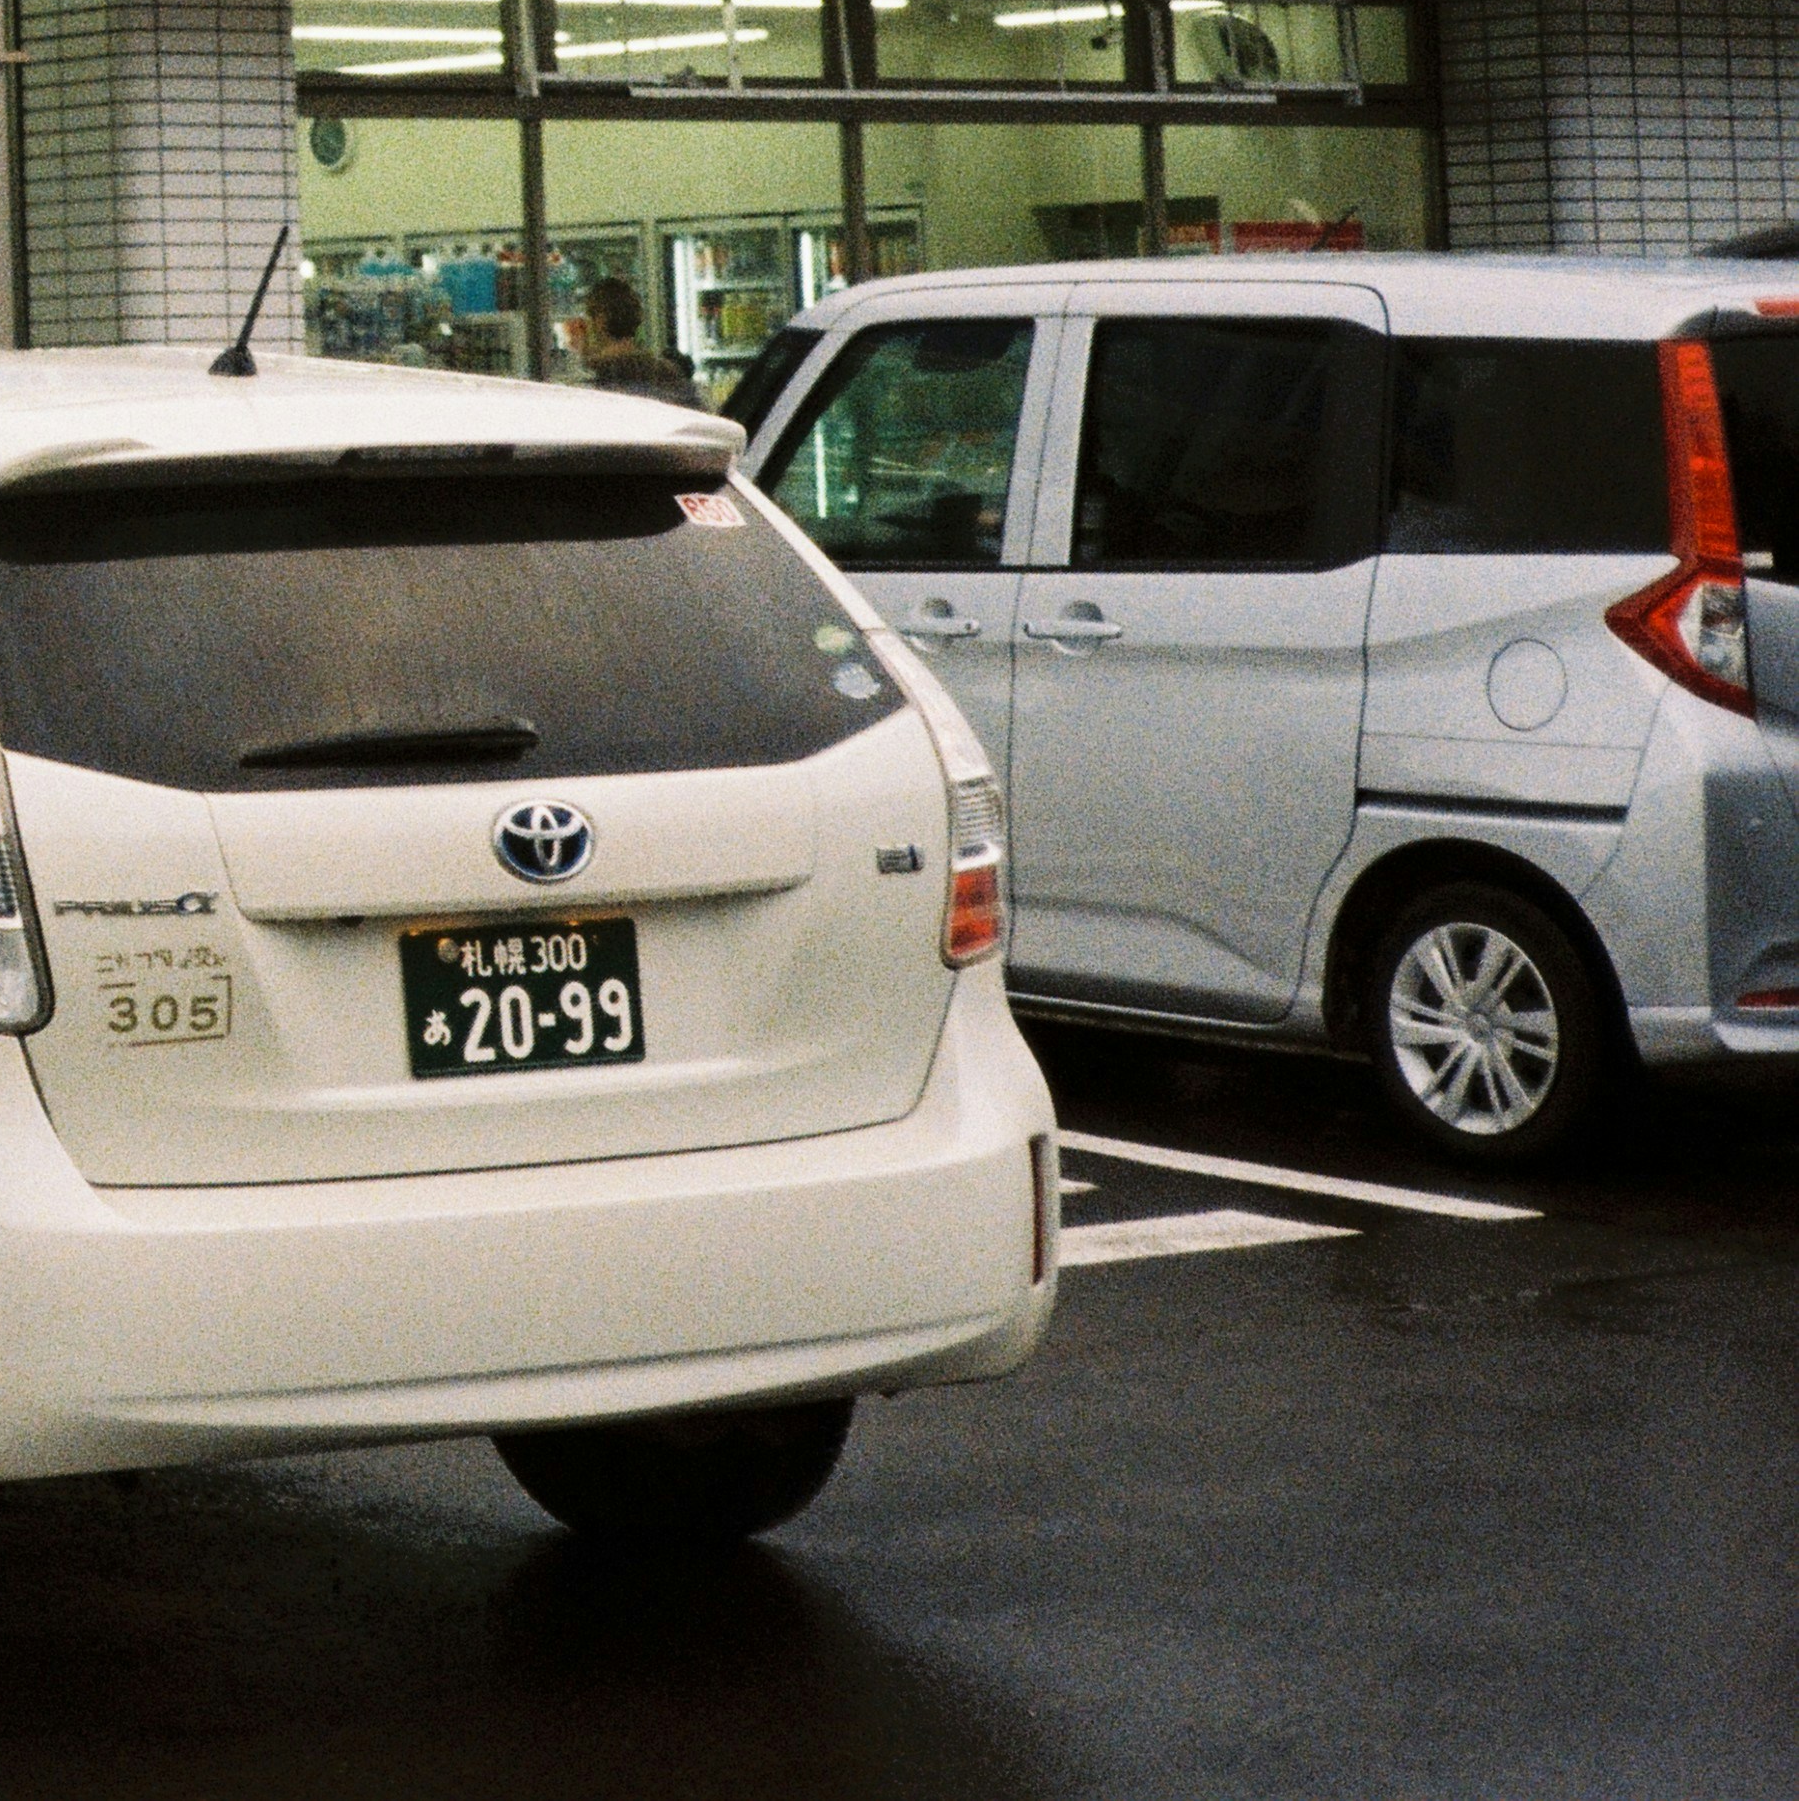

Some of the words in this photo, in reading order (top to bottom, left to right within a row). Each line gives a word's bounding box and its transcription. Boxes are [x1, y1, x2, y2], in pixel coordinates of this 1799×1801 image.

[108, 993, 219, 1034] 305
[423, 1009, 452, 1046] あ
[459, 977, 633, 1063] 20-99
